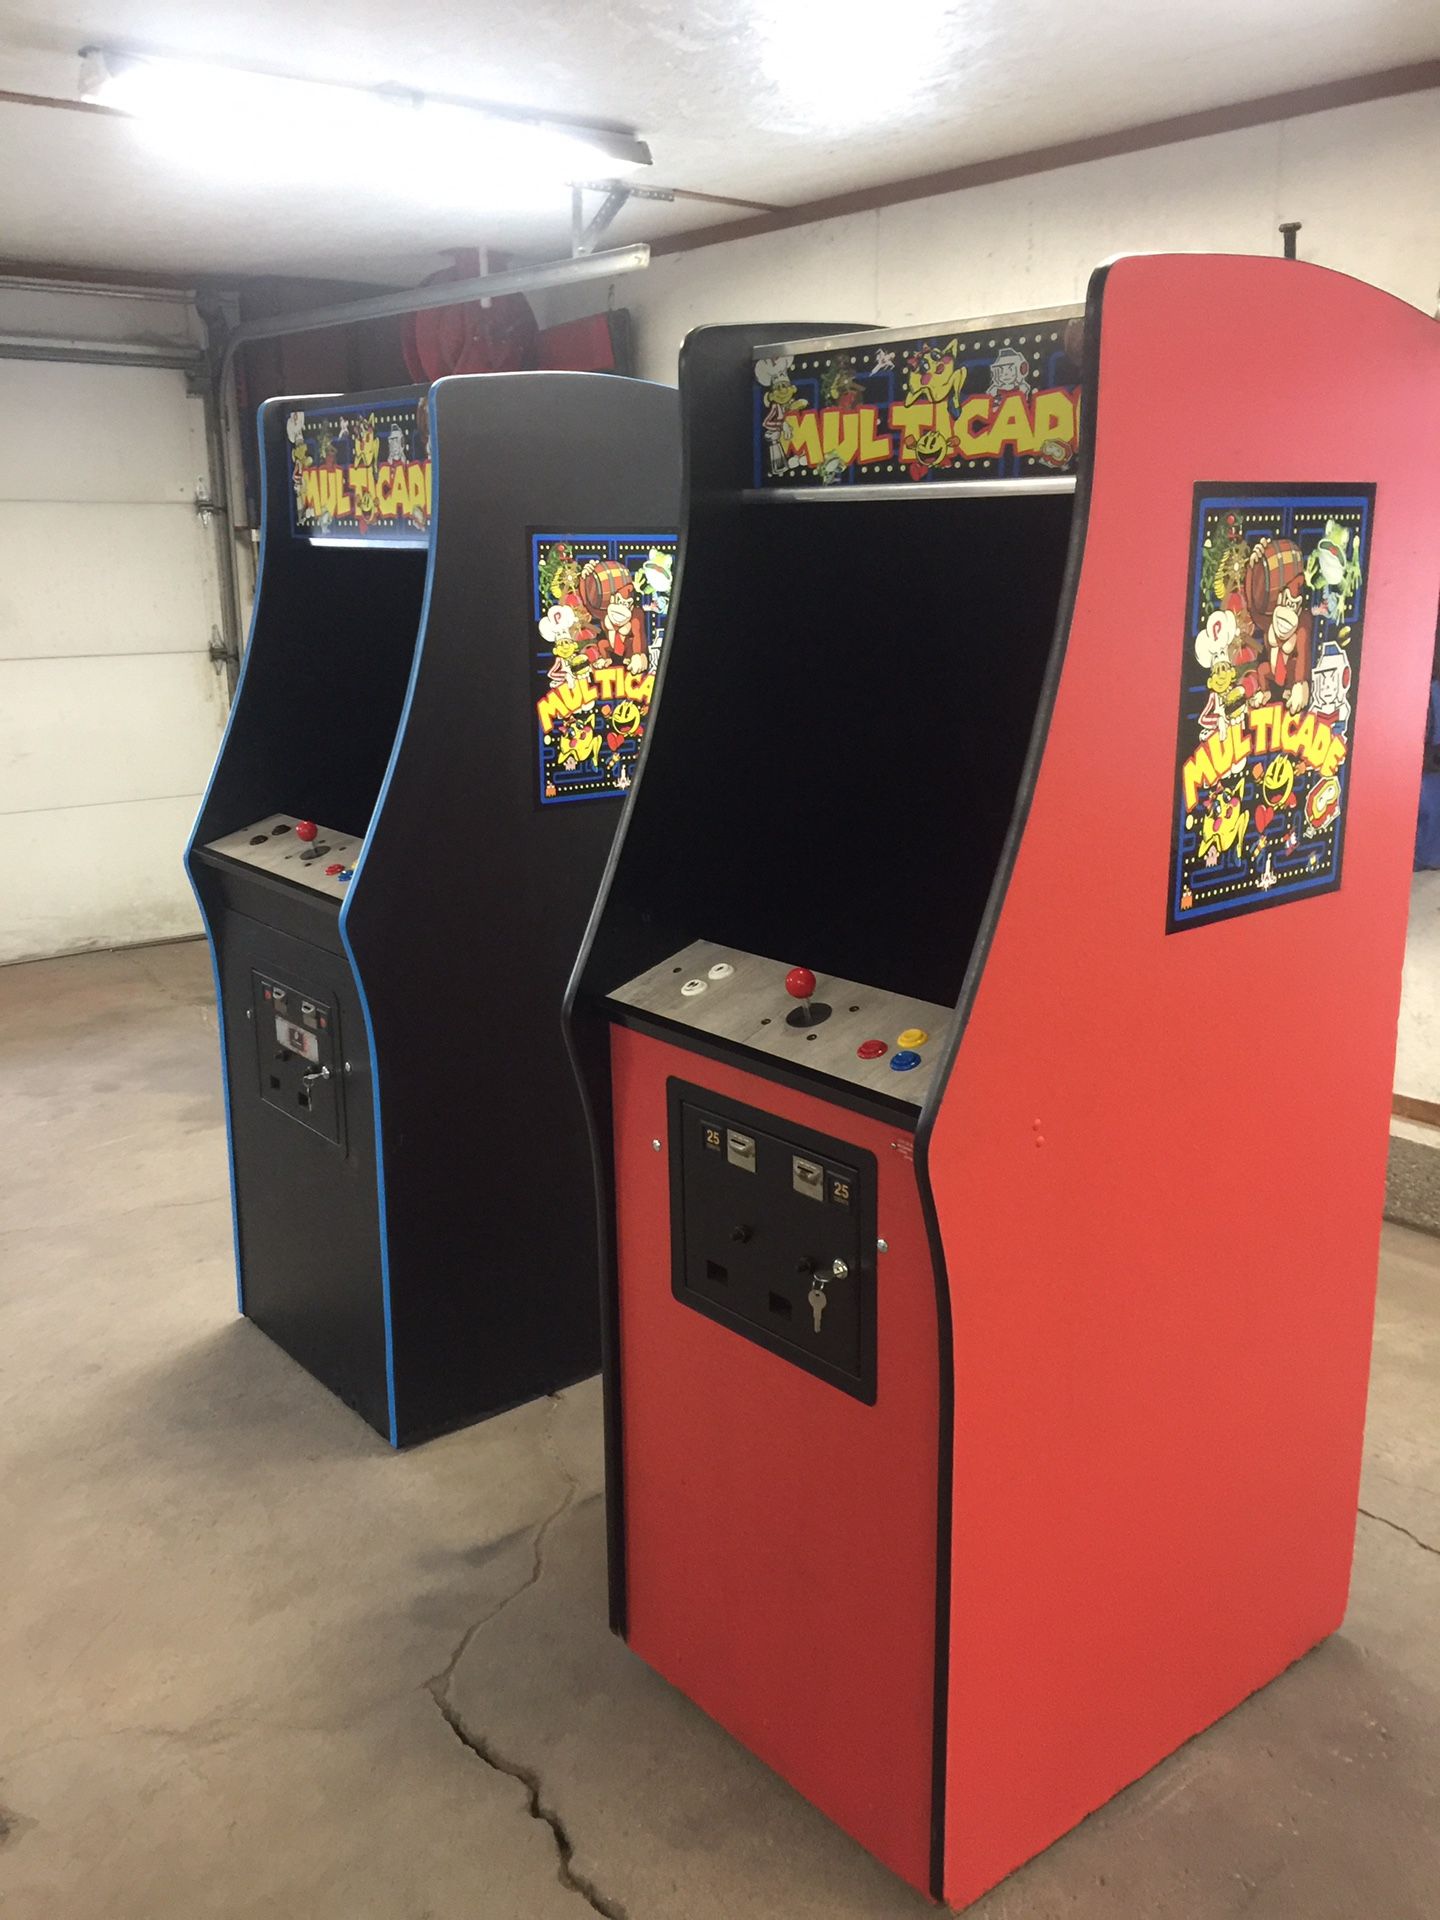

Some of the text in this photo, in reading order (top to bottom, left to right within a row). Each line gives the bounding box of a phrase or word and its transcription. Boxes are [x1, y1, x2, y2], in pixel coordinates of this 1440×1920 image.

[780, 385, 1081, 468] MULTICAD
[537, 665, 656, 734] MULTICA
[1184, 702, 1346, 813] MULTICADE
[706, 1129, 720, 1145] 25
[833, 1181, 849, 1199] 25
